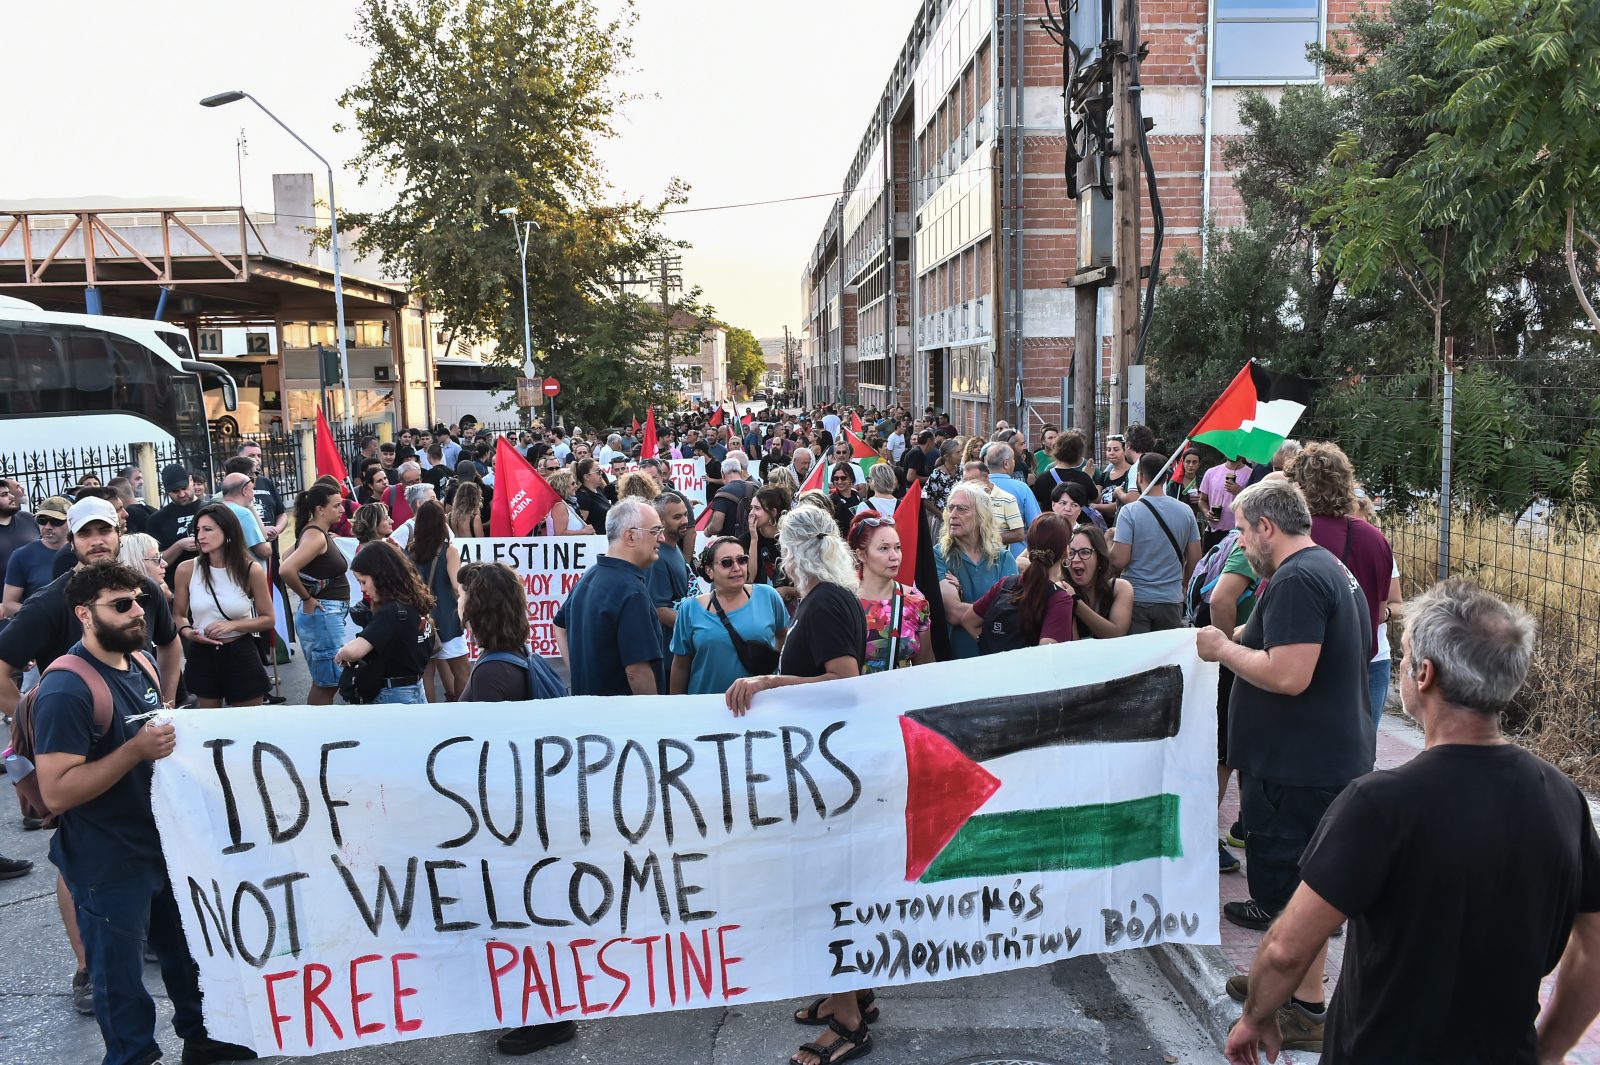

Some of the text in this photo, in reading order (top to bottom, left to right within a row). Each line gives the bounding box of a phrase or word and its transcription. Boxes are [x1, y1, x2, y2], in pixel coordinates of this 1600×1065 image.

[200, 332, 217, 351] 11
[247, 336, 267, 353] 12
[460, 543, 587, 569] ALESTINE
[520, 573, 553, 596] ΜΟΥ
[203, 720, 862, 855] IDF SUPPORTERS
[188, 849, 717, 968] NOT WELCOME
[829, 878, 1044, 931] Συντονισμός
[828, 893, 1199, 980] Συλλογικοτήτων Βόλου
[263, 924, 750, 1050] FREE PALESTINE
